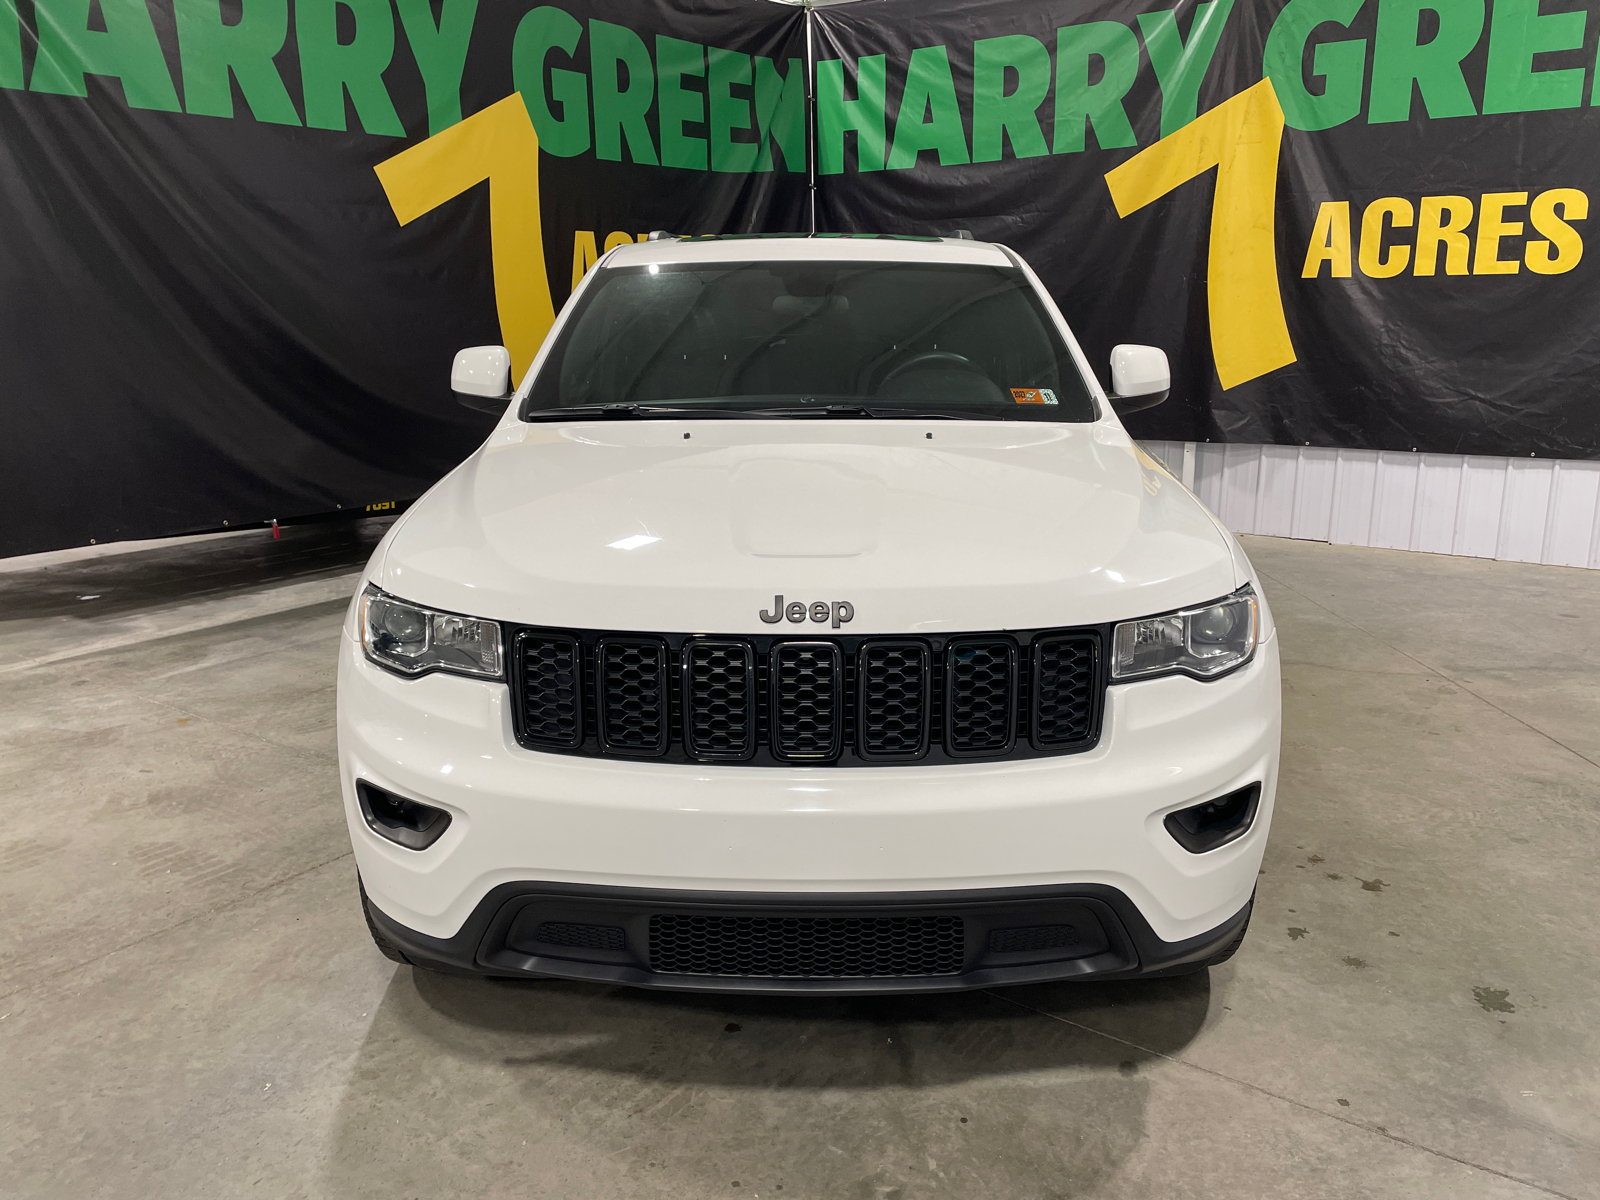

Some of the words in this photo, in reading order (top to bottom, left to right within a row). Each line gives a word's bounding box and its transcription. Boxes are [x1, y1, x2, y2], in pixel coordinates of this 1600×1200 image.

[0, 0, 479, 138] ARRY
[512, 5, 806, 173] GREEN
[817, 0, 1235, 175] HARRY
[1262, 0, 1600, 131] GRE
[373, 91, 557, 394] 7
[1105, 76, 1297, 390] 7
[1301, 188, 1589, 279] ACRES
[759, 594, 855, 629] Jeep
